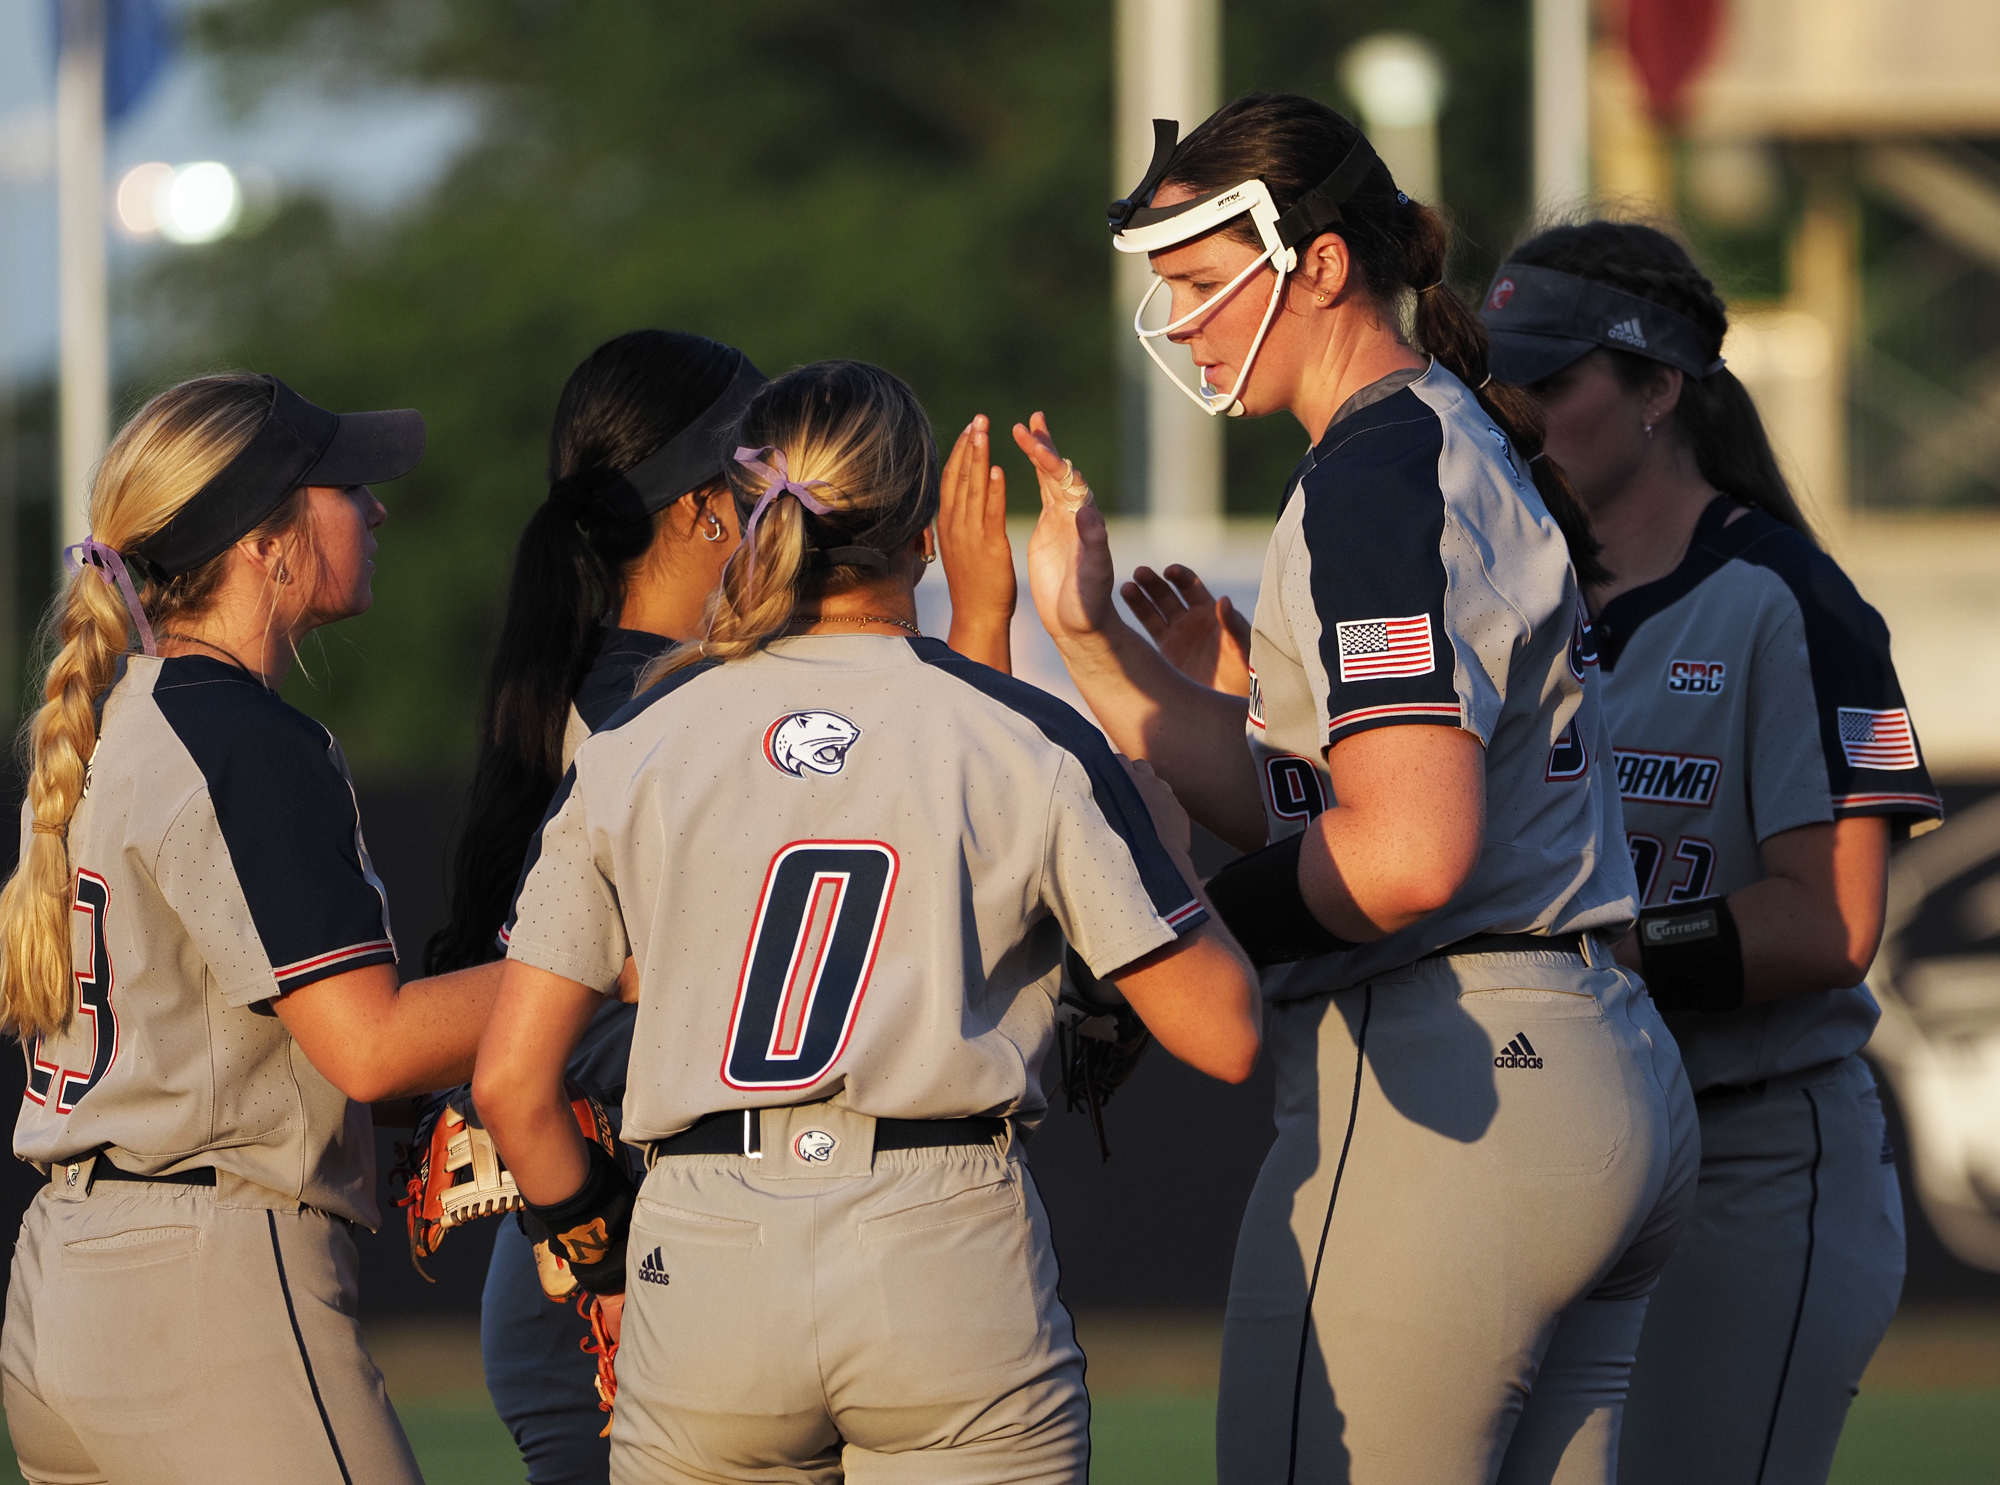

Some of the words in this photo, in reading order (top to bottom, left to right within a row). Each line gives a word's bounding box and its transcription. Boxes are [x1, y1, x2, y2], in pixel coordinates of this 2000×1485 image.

[1607, 328, 1648, 349] adidas
[1669, 660, 1725, 694] SBC
[1613, 752, 1719, 802] BAMA
[1646, 920, 1710, 940] CUTTERS
[720, 839, 900, 1091] 0
[1494, 1053, 1544, 1070] adidas
[638, 1266, 670, 1286] adidas
